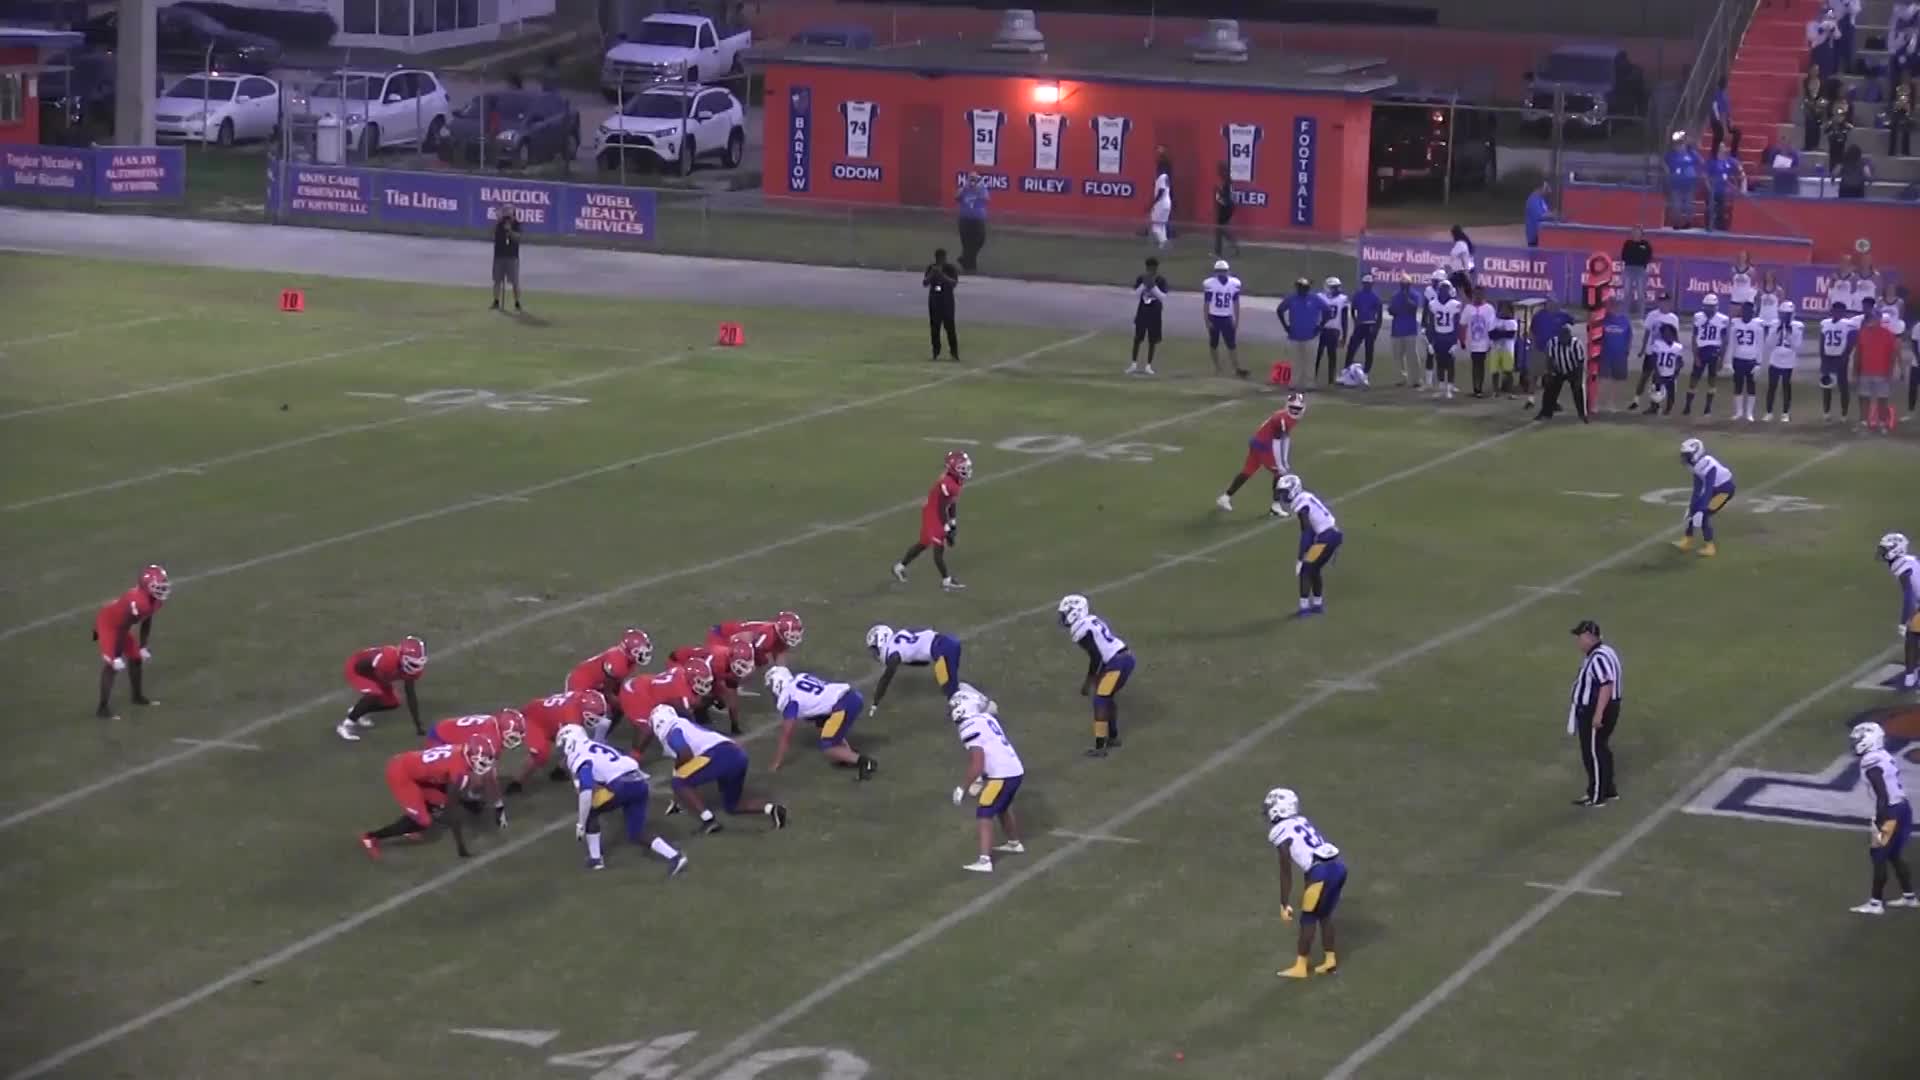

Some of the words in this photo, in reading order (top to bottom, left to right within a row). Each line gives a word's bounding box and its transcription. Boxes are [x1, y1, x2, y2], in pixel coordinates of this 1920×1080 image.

[850, 121, 867, 135] 74
[976, 128, 993, 143] 51
[1042, 133, 1052, 147] 5
[1101, 136, 1119, 150] 24
[791, 117, 806, 189] BARTOW
[1231, 143, 1250, 158] 64
[834, 165, 880, 180] ODOM
[1297, 121, 1310, 221] FOOTBALL
[299, 172, 327, 184] SKIN
[328, 175, 360, 187] CARE
[1024, 178, 1065, 193] RILEY
[480, 187, 550, 205] BADCOCK
[1085, 182, 1132, 196] FLOYD
[384, 189, 409, 206] Tia
[413, 192, 458, 211] Linas
[586, 193, 633, 208] VOGEL
[581, 206, 638, 222] REALTY
[575, 218, 644, 235] SERVICES
[1362, 246, 1404, 264] Kinder
[1483, 257, 1532, 273] CRUSH
[1534, 261, 1548, 275] IT
[1476, 274, 1553, 292] NUTRITION
[1687, 277, 1710, 292] Jim
[283, 293, 298, 309] 10
[1436, 310, 1450, 327] 21
[721, 326, 737, 344] 20
[1736, 329, 1754, 345] 23
[1659, 352, 1676, 368] 16
[1273, 364, 1291, 383] 30
